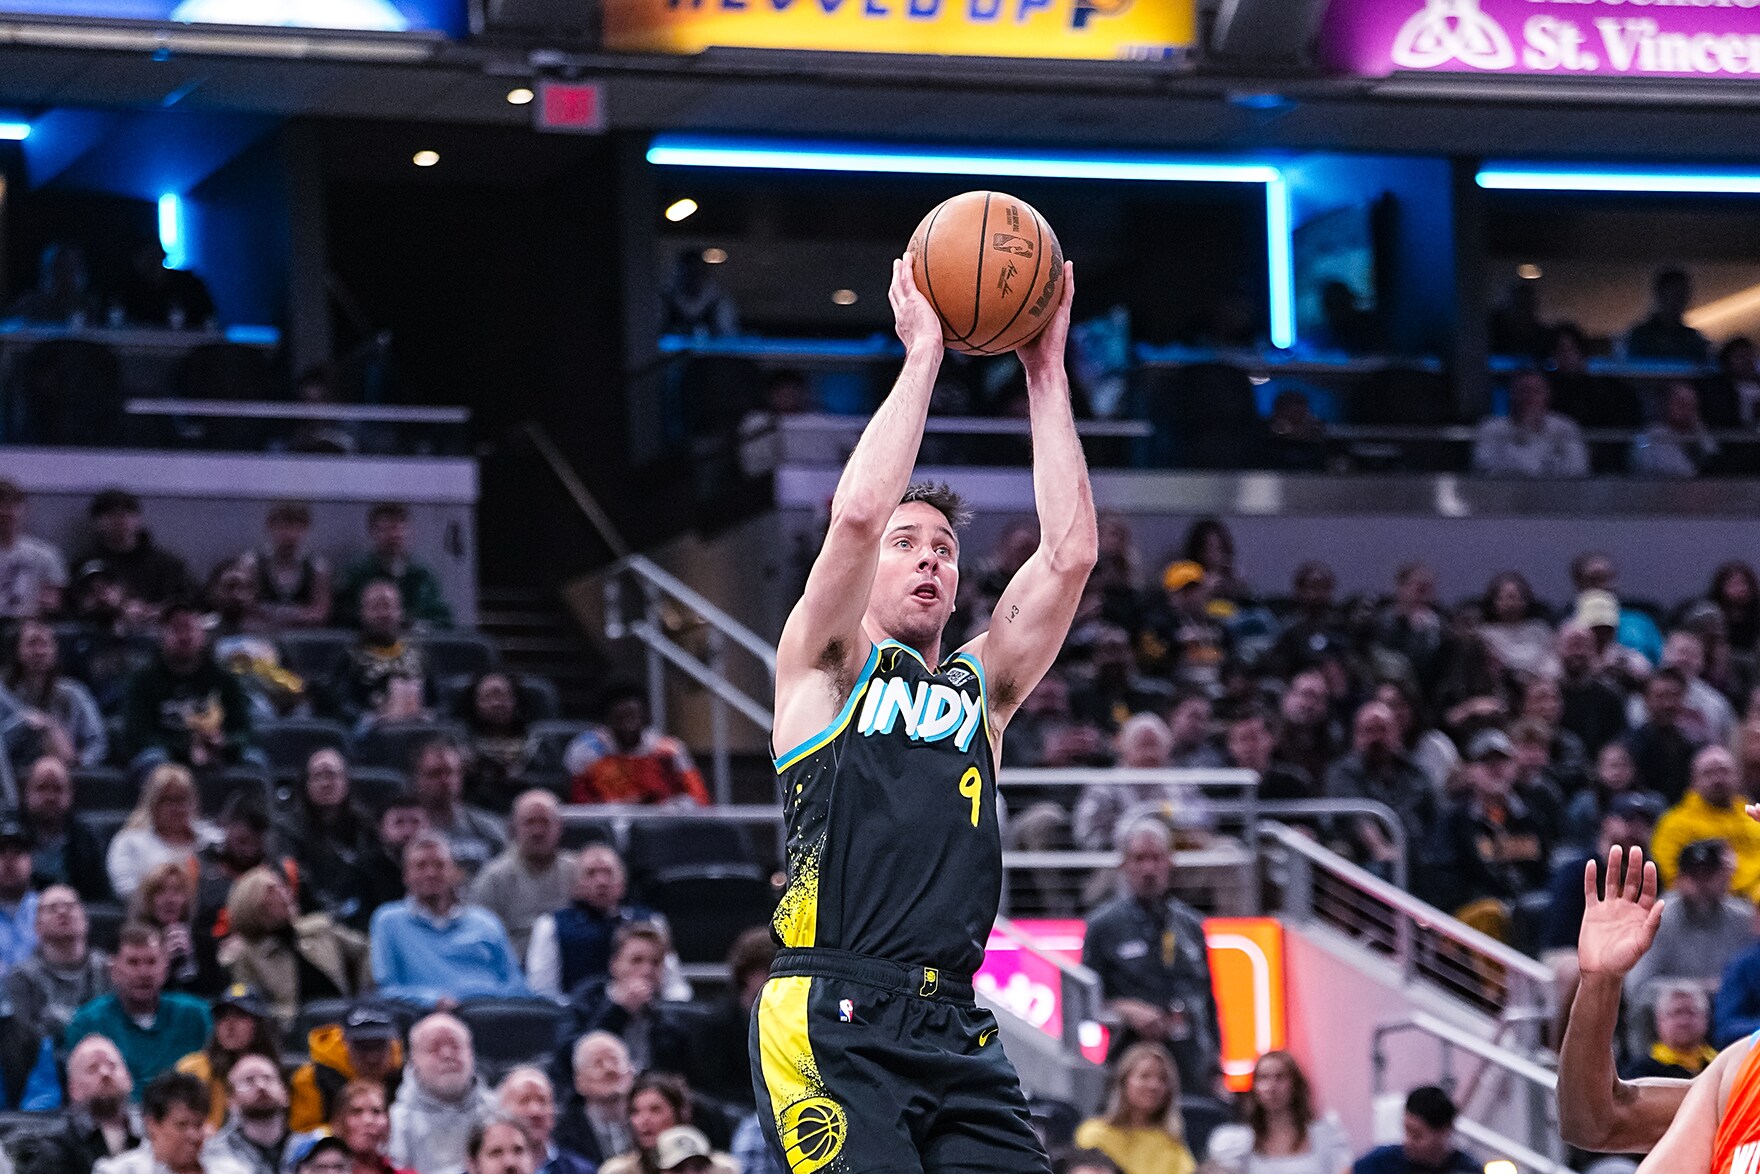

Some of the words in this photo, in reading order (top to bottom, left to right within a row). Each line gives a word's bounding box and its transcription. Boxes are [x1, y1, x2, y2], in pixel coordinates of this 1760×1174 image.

[1523, 15, 1598, 71] St.
[857, 676, 981, 753] INDY
[958, 766, 982, 827] 9
